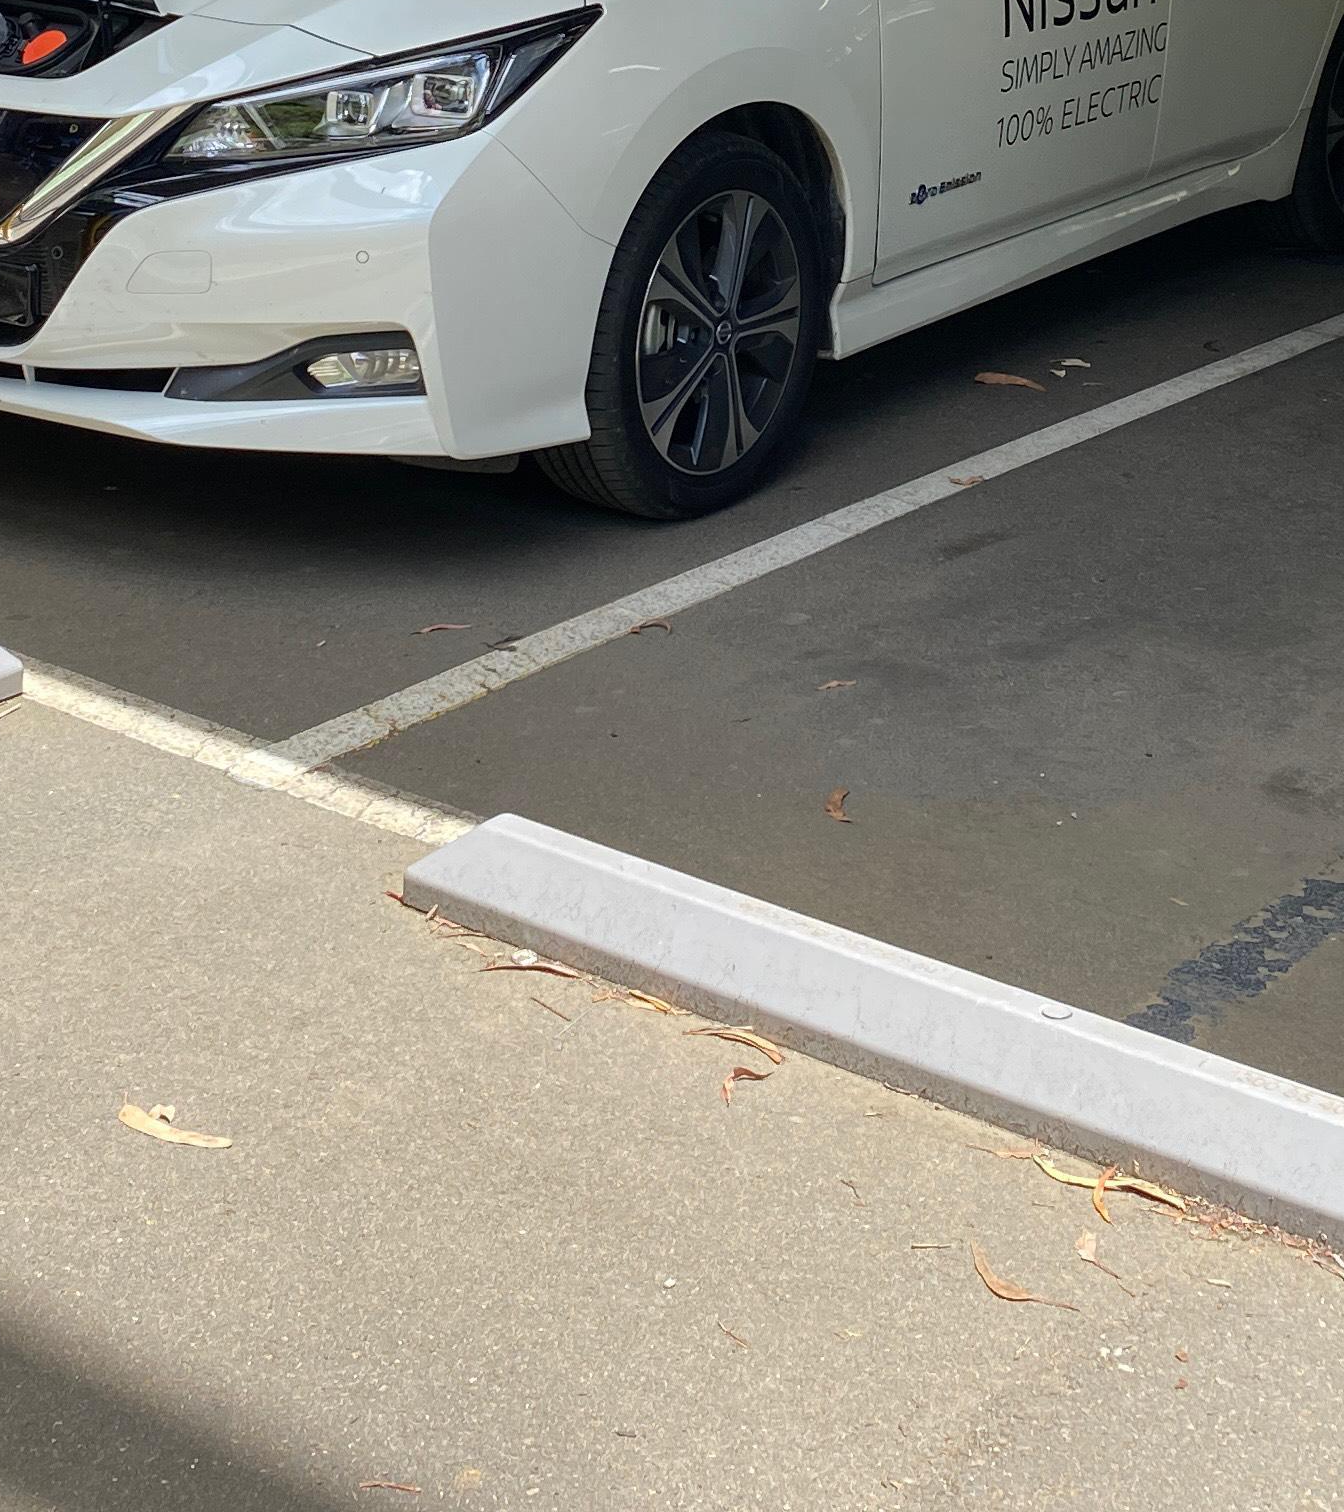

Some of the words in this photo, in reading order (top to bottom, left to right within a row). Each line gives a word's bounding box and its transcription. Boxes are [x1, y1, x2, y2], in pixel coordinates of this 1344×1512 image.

[1000, 45, 1074, 94] SIMPLY
[1078, 21, 1168, 76] AMAZING
[996, 105, 1054, 149] 100%
[1061, 74, 1163, 131] ELECTRIC
